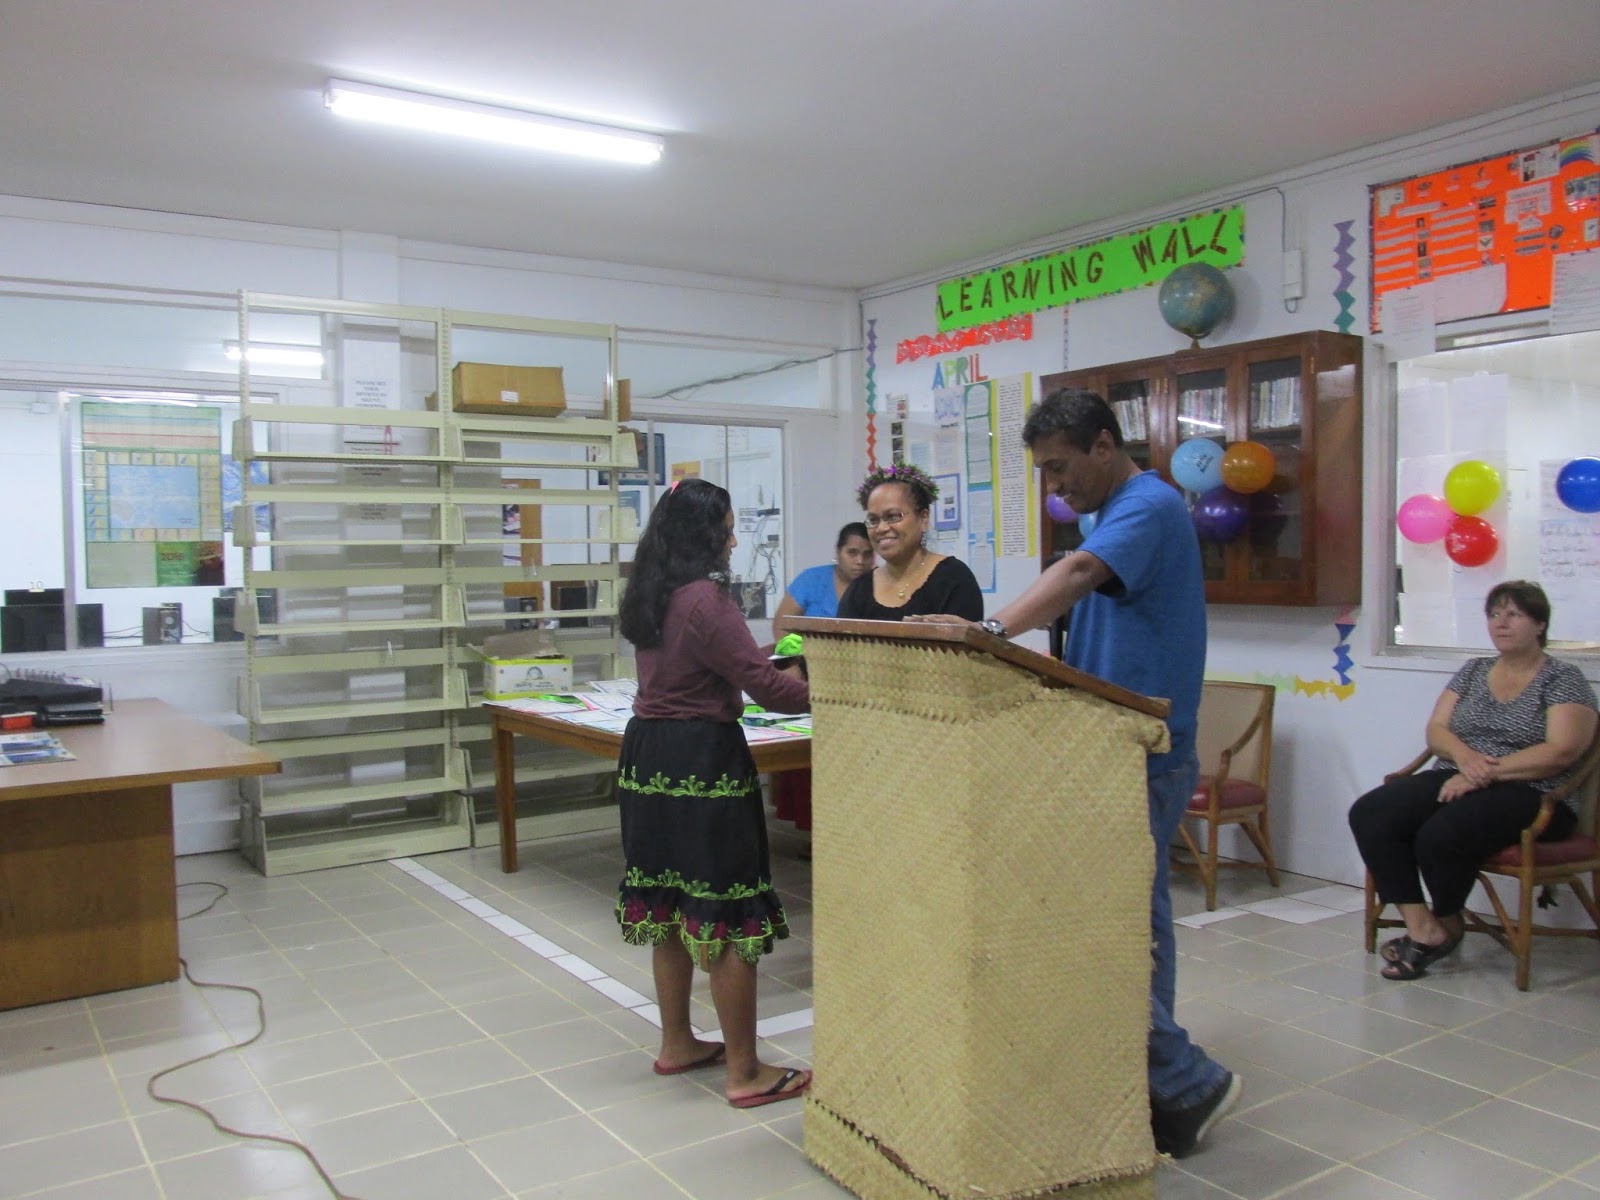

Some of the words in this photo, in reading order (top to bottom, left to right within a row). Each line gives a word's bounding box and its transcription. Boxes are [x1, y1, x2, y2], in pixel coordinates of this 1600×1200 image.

[937, 250, 1104, 320] LEARNING
[1132, 214, 1228, 274] WALL
[932, 353, 989, 391] APRIL
